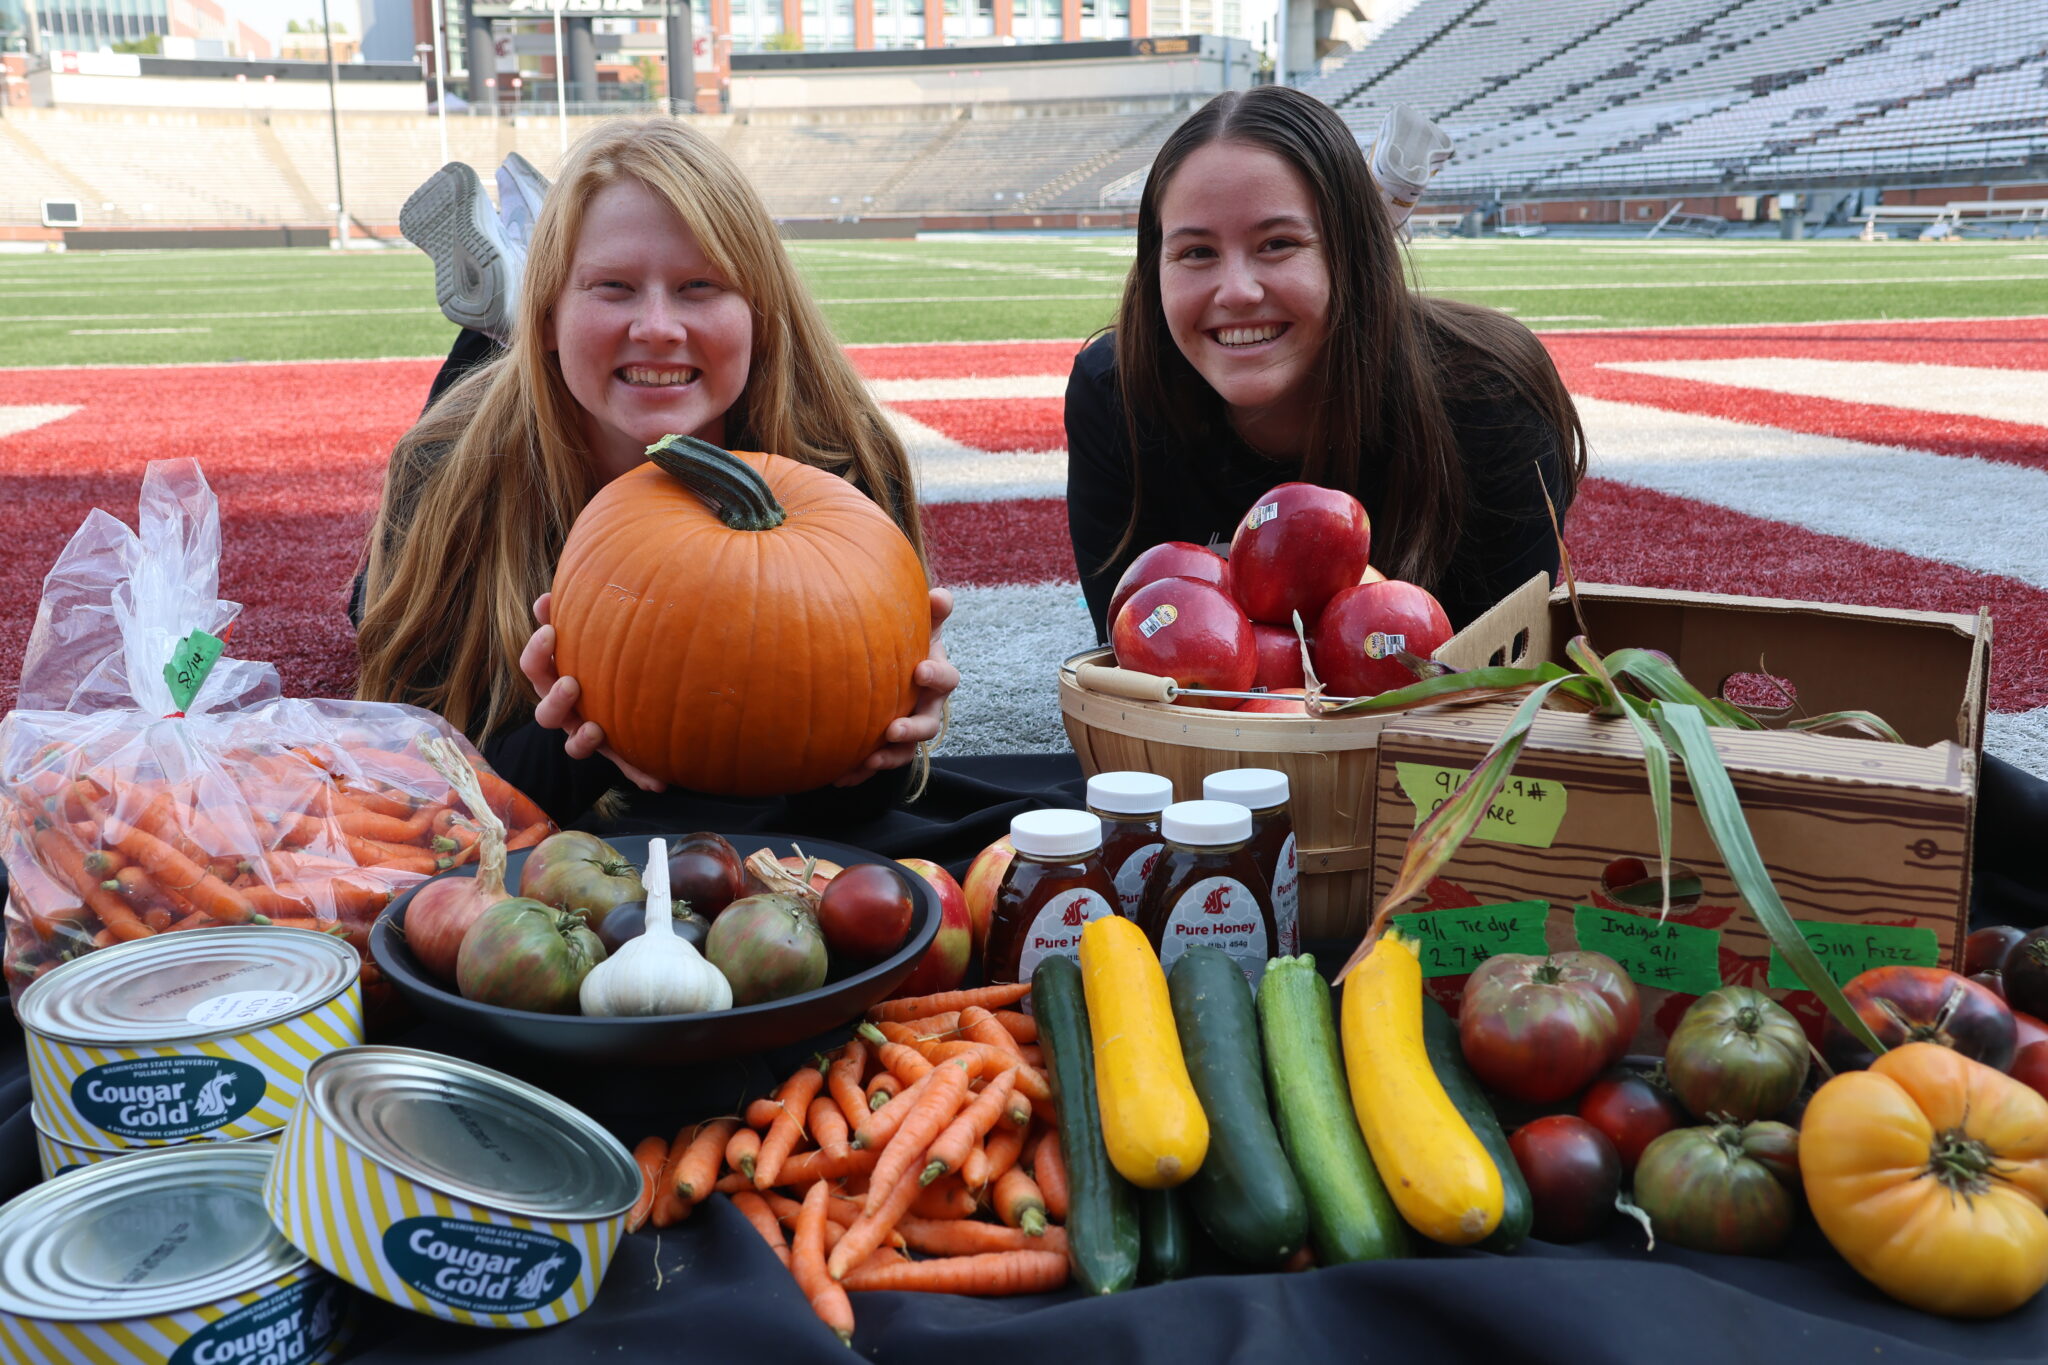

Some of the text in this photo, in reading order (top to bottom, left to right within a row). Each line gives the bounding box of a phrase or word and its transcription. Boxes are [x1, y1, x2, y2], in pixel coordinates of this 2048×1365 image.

[1119, 894, 1140, 903] Pur
[1176, 922, 1256, 935] Pure Honey
[1601, 916, 1680, 942] Indigo A
[1035, 937, 1069, 949] Pure
[1806, 934, 1917, 961] Gin Fizz
[102, 1058, 219, 1075] WASHINGTON STATE UNIVERSITY
[87, 1080, 186, 1109] Cougar
[119, 1101, 189, 1127] Gold
[409, 1228, 521, 1277] Cougar
[435, 1266, 511, 1300] Gold
[193, 1308, 304, 1365] Cougar
